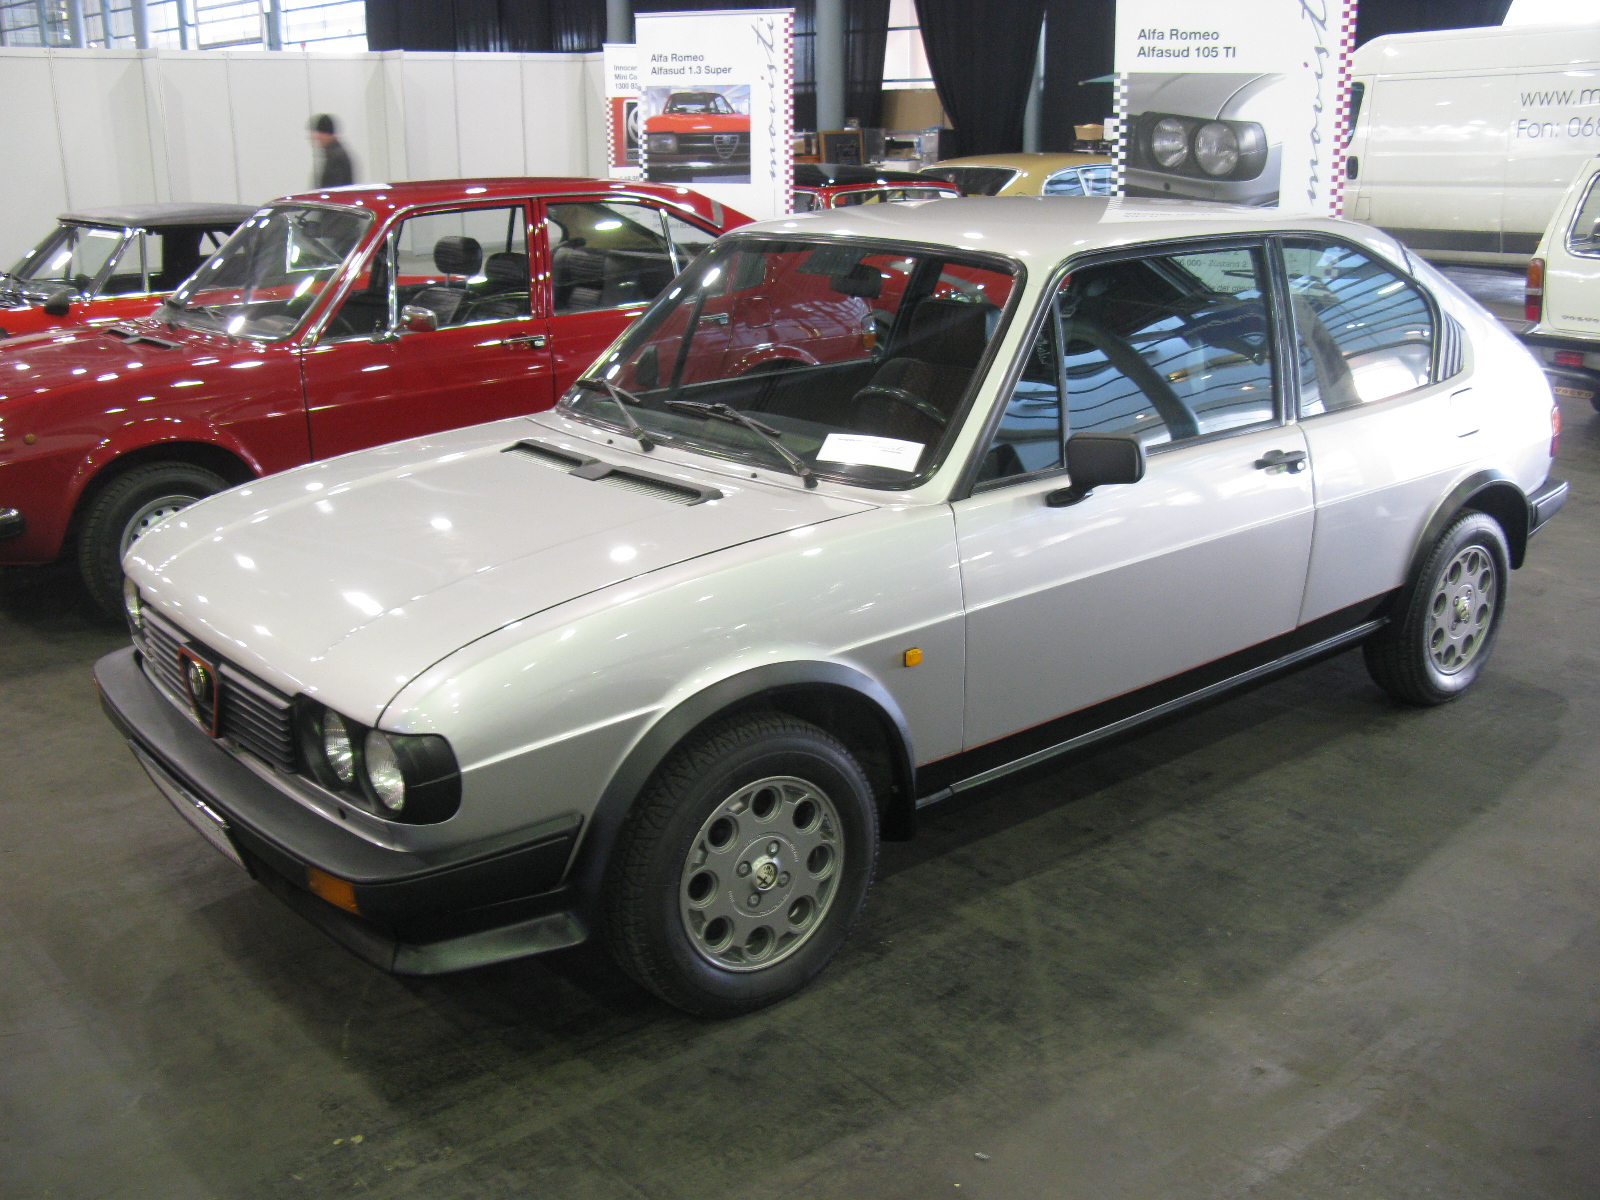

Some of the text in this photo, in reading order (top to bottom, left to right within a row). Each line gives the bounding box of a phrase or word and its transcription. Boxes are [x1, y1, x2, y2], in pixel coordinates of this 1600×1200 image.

[1137, 28, 1219, 40] Alfa Romeo
[650, 53, 704, 62] Alfa Romeo
[1137, 46, 1236, 58] Alfasud 105 TI
[650, 65, 732, 76] Alfasud 1.3 Super
[1517, 118, 1560, 138] Fon:
[1208, 259, 1240, 268] Zustand
